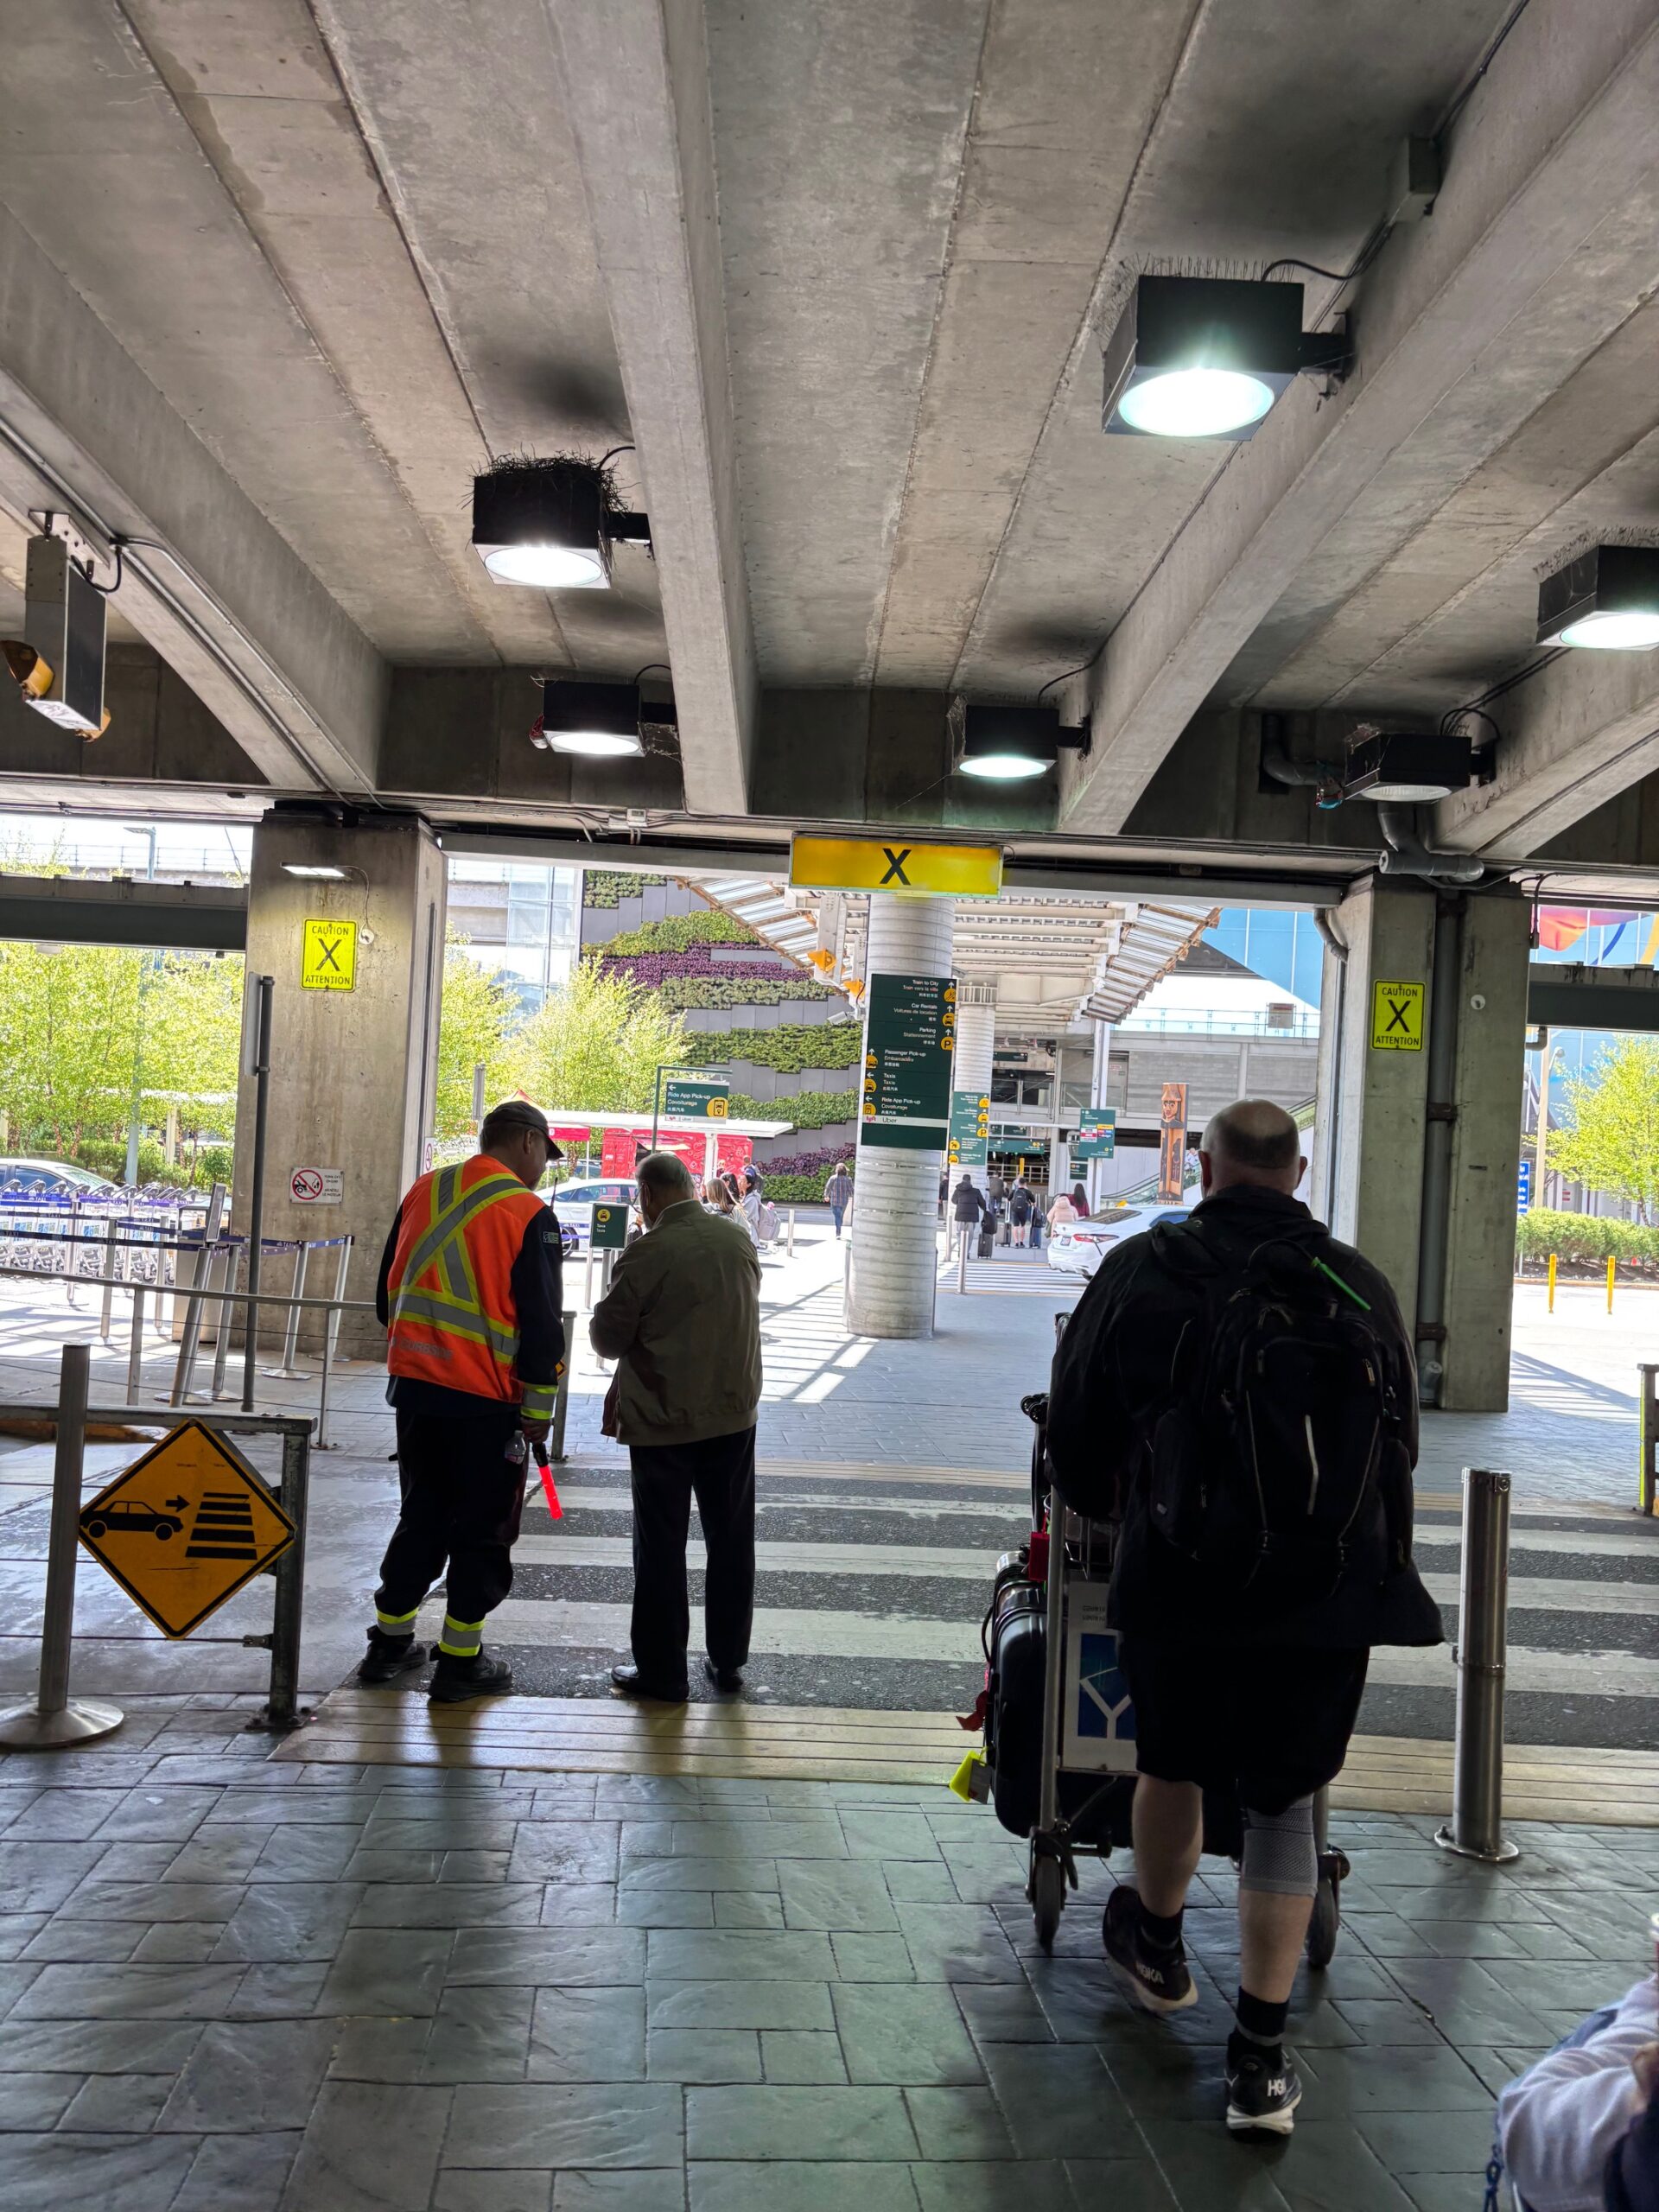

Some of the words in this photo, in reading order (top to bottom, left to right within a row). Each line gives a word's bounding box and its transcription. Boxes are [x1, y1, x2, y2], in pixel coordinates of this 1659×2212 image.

[880, 848, 912, 886] X
[312, 926, 349, 935] CAUTION
[315, 938, 342, 971] X
[305, 975, 350, 984] ATTENTION
[1382, 988, 1417, 996] CAUTION
[1385, 999, 1411, 1033] X
[1376, 1035, 1419, 1046] ATTENTION
[400, 1338, 454, 1359] CURBSIDE
[1135, 1961, 1165, 1985] HOKA
